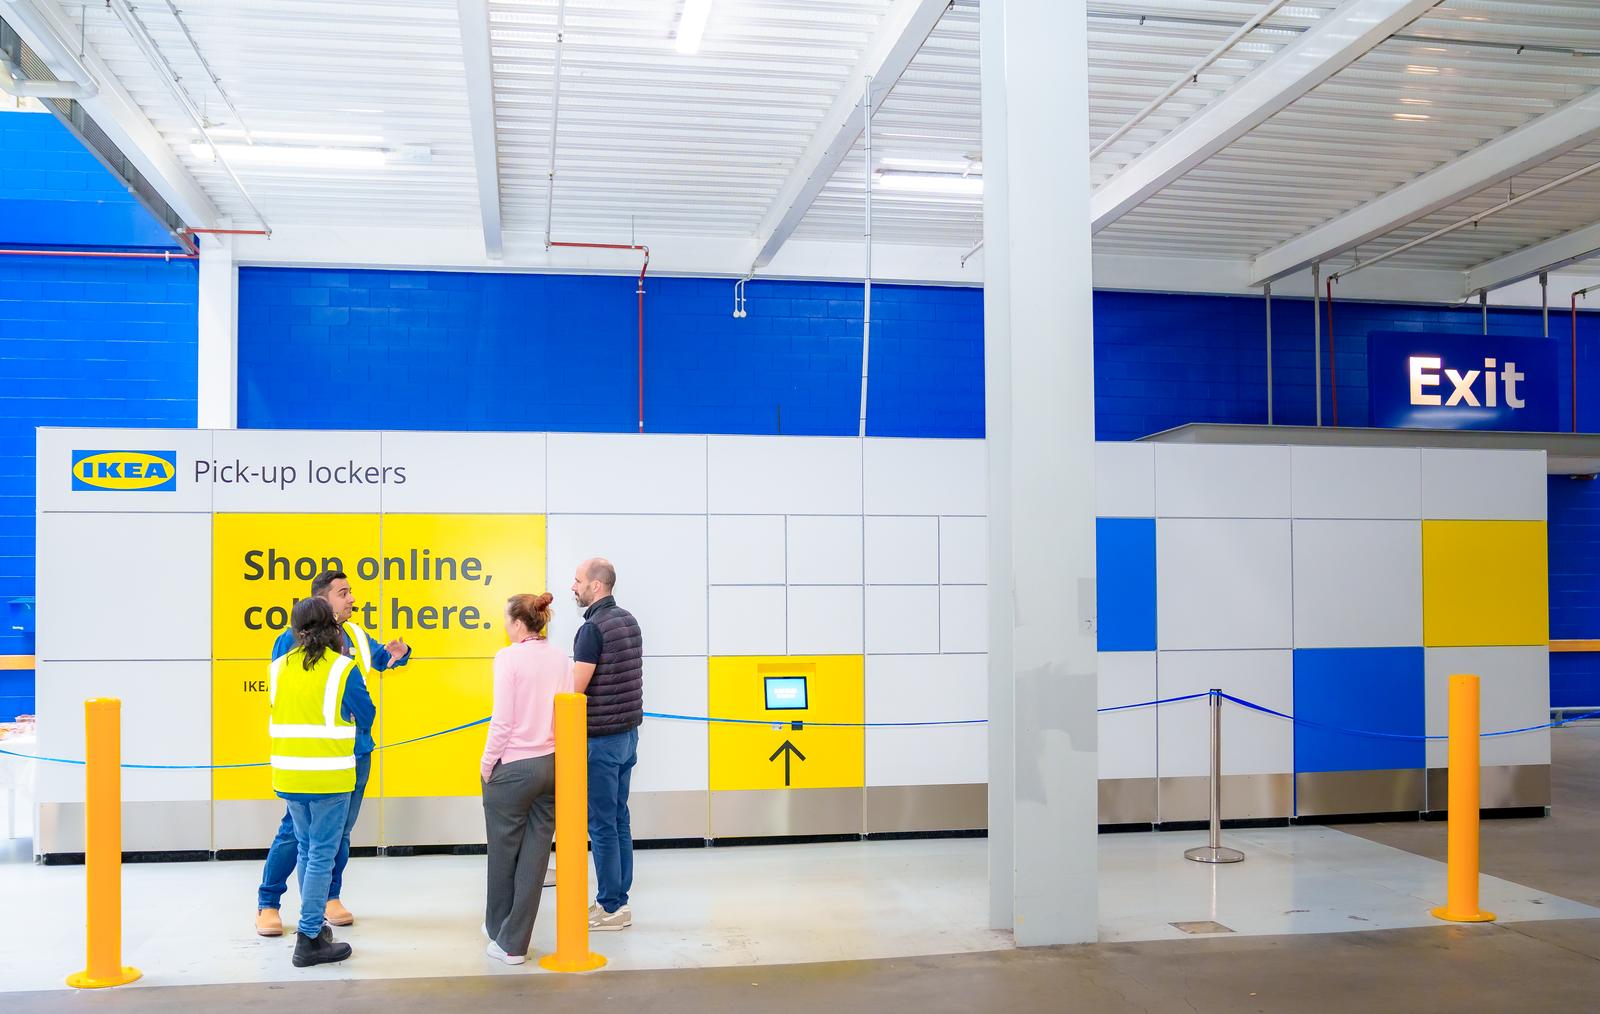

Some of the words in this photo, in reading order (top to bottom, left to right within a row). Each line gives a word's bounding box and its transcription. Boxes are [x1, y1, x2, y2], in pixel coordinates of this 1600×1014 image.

[1408, 356, 1526, 409] Exit
[83, 462, 168, 478] IKEA
[195, 459, 297, 491] Pick-up
[308, 459, 407, 484] lockers
[356, 548, 493, 586] online,
[391, 597, 492, 631] here.
[243, 680, 269, 692] IKE
